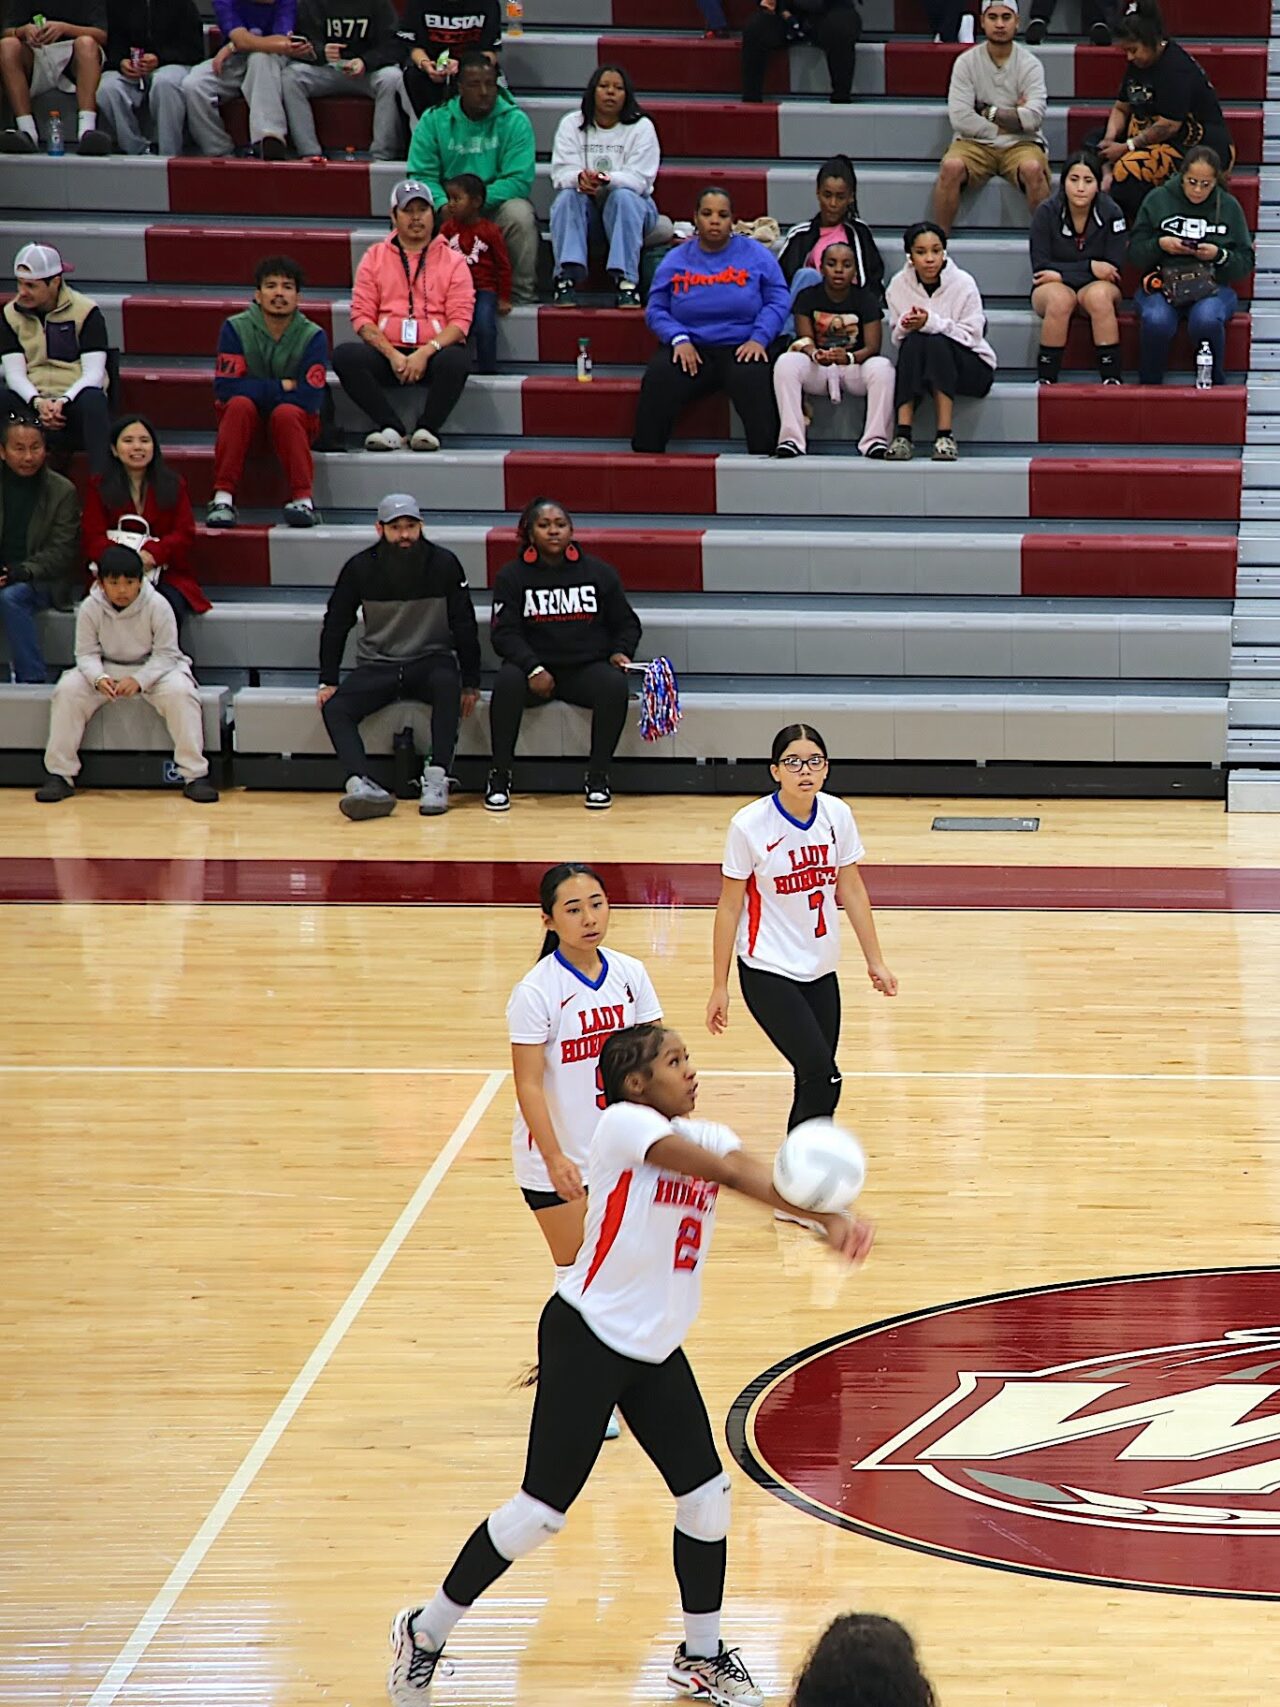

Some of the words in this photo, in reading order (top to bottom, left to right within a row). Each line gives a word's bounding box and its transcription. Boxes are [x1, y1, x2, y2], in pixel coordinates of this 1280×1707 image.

[327, 18, 368, 38] 1977
[789, 845, 828, 871] LADY
[808, 891, 827, 938] 7
[578, 1004, 624, 1036] LADY
[673, 1215, 702, 1272] 2
